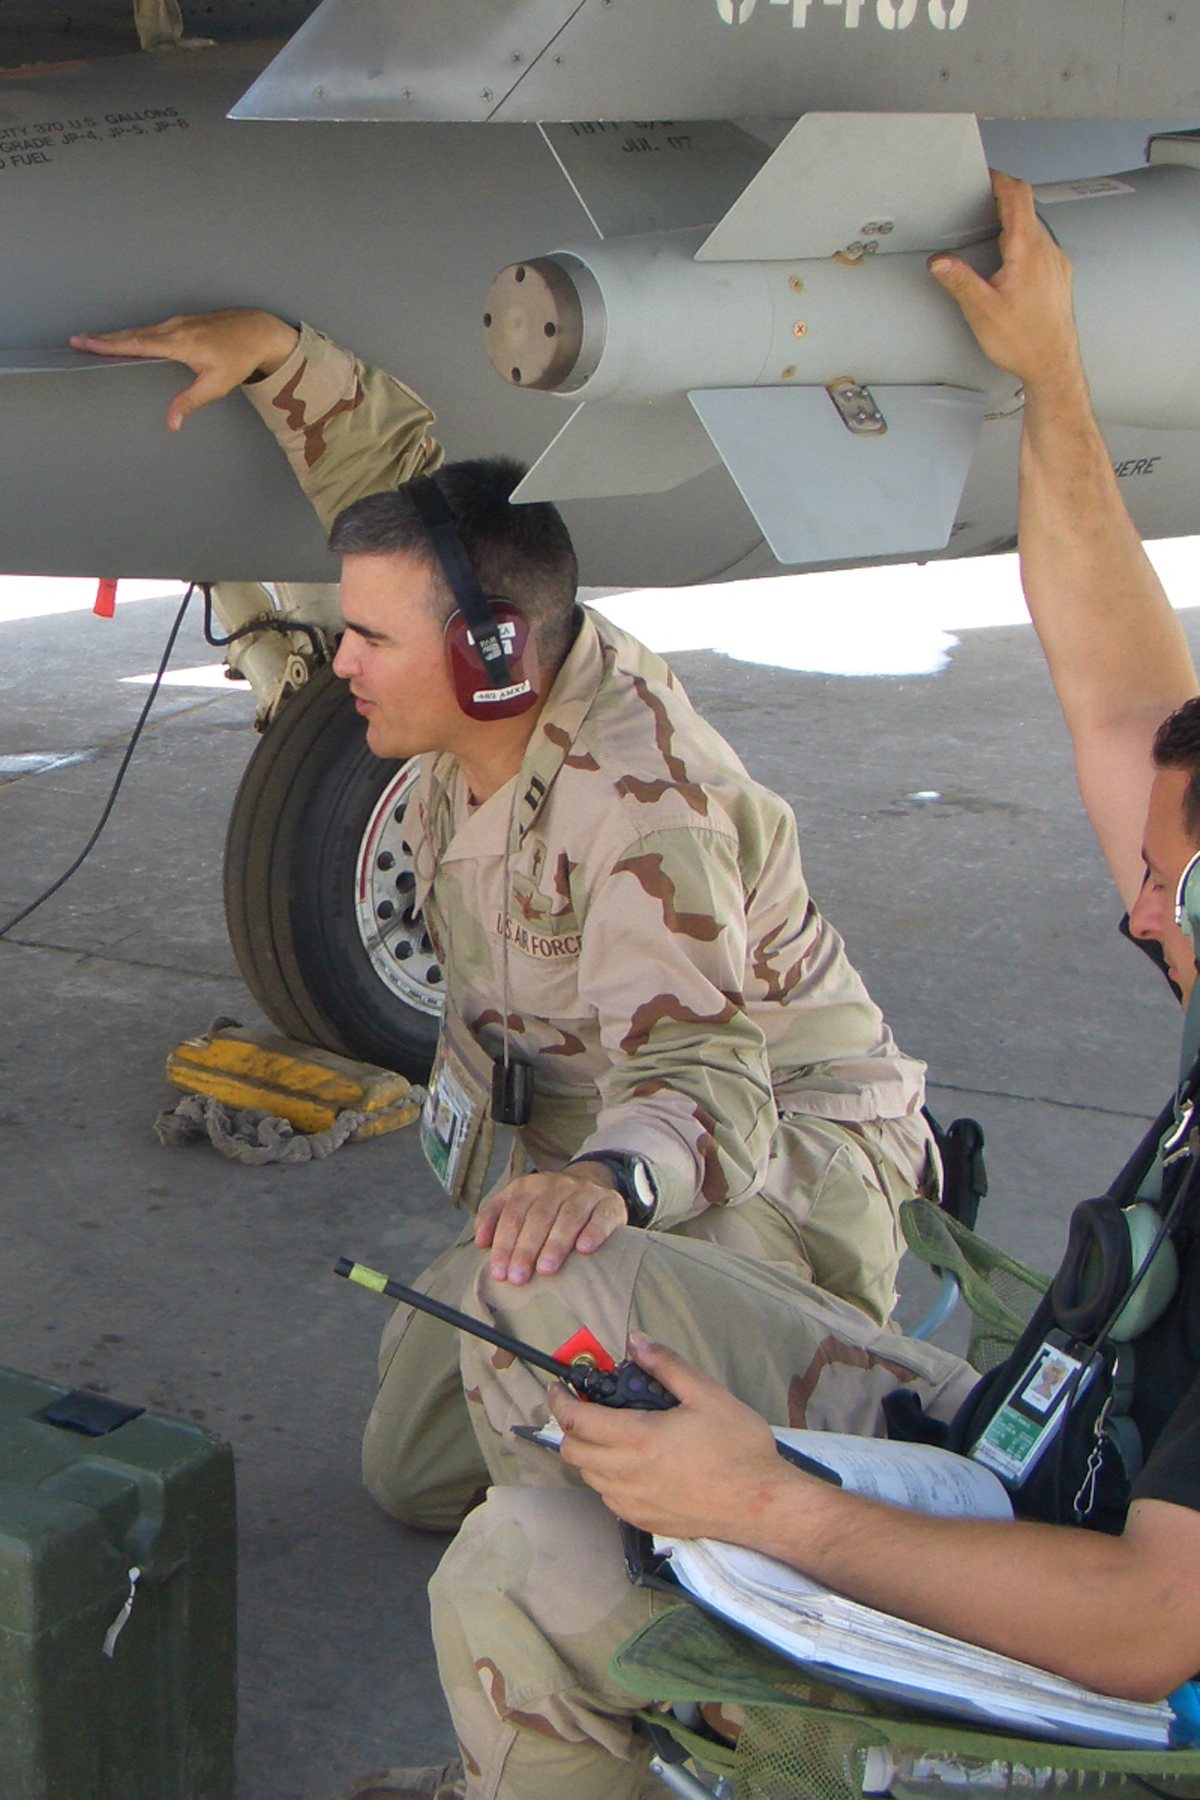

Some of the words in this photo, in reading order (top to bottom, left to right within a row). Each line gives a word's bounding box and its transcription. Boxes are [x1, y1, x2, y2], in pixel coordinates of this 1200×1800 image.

[33, 122, 64, 134] 370
[105, 107, 179, 125] GALLONS
[0, 138, 56, 154] GRADE
[10, 152, 53, 168] FUEL
